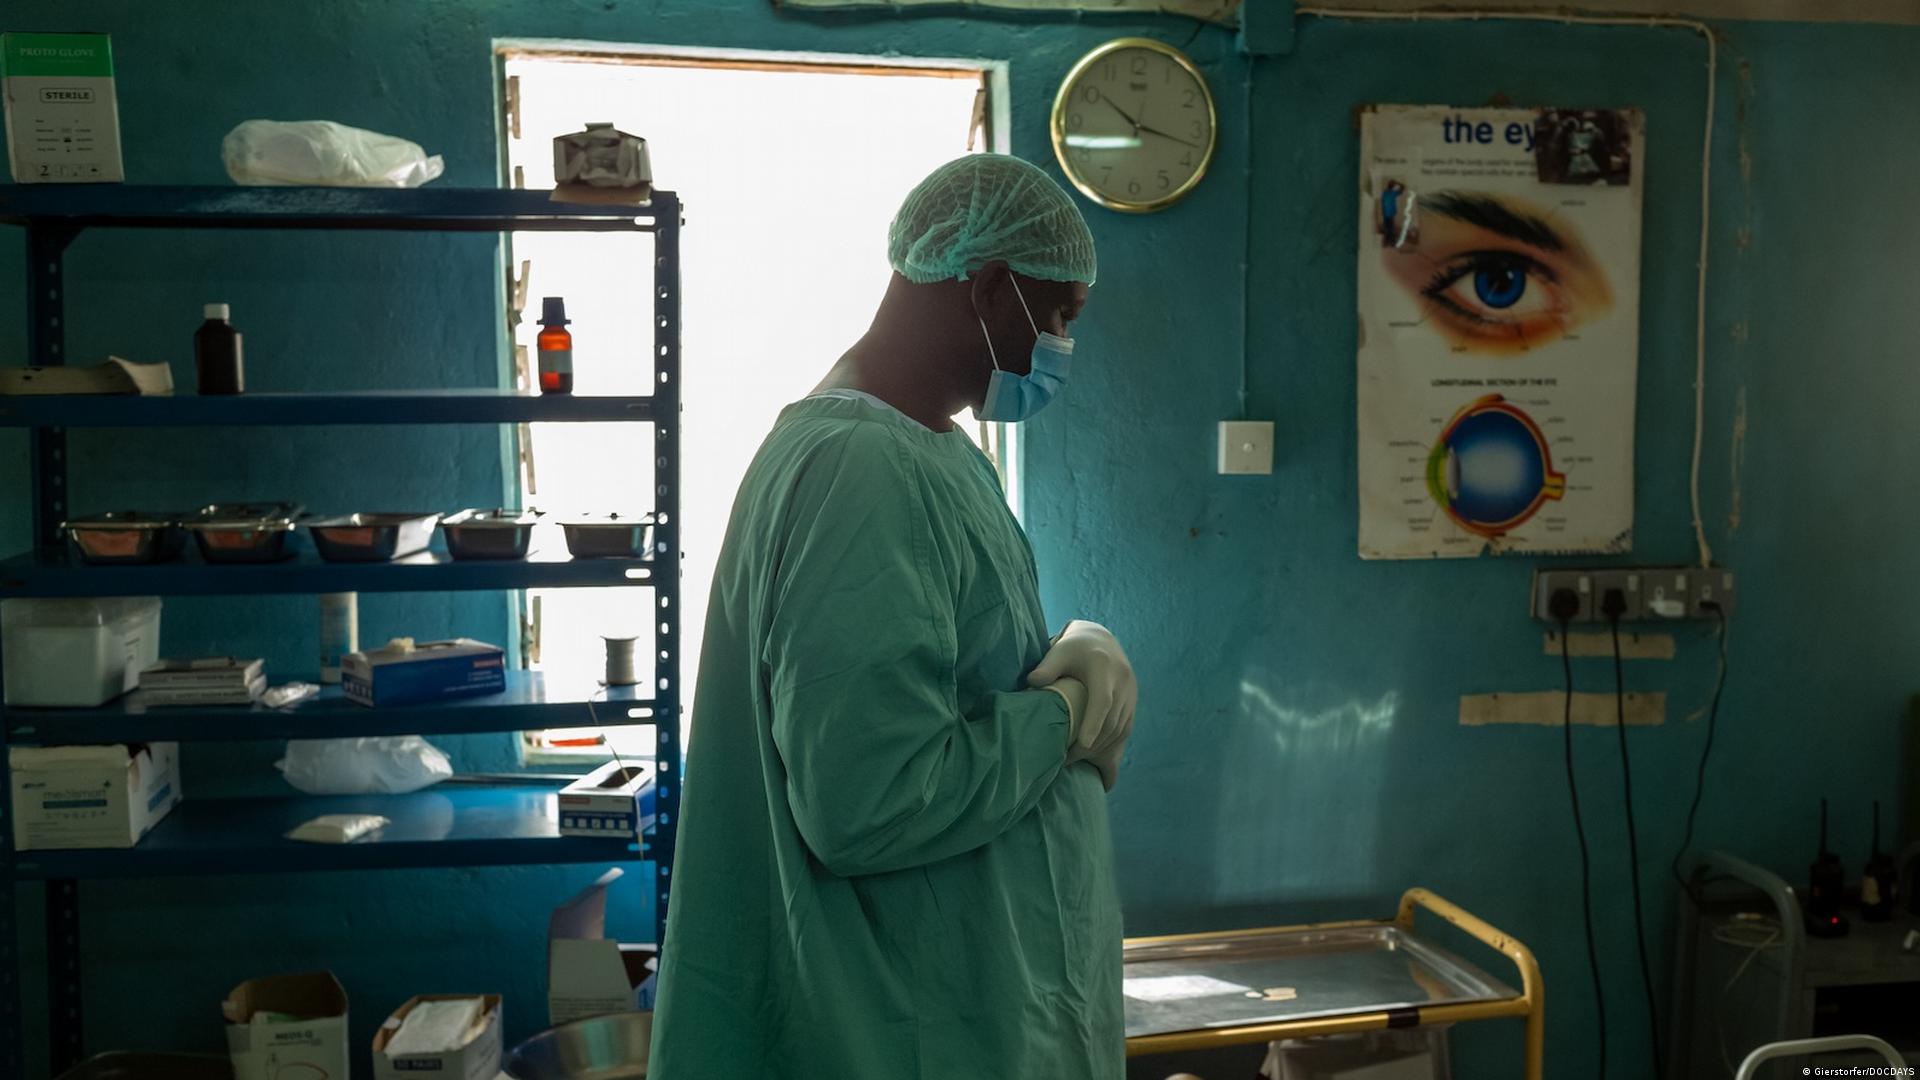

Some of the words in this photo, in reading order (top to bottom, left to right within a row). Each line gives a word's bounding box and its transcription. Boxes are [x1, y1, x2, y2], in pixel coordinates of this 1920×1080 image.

[20, 47, 57, 56] PROTO
[59, 48, 95, 57] GLOVE
[1104, 64, 1116, 82] 11
[1130, 56, 1147, 75] 12
[45, 91, 91, 100] STERILE
[1080, 85, 1099, 104] 10
[1182, 89, 1195, 108] 2
[1190, 120, 1202, 139] 3
[1443, 114, 1493, 143] the
[1505, 122, 1537, 152] ey
[1180, 152, 1191, 169] 4
[1101, 166, 1113, 185] 7
[1158, 170, 1170, 189] 5
[1128, 176, 1141, 195] 6
